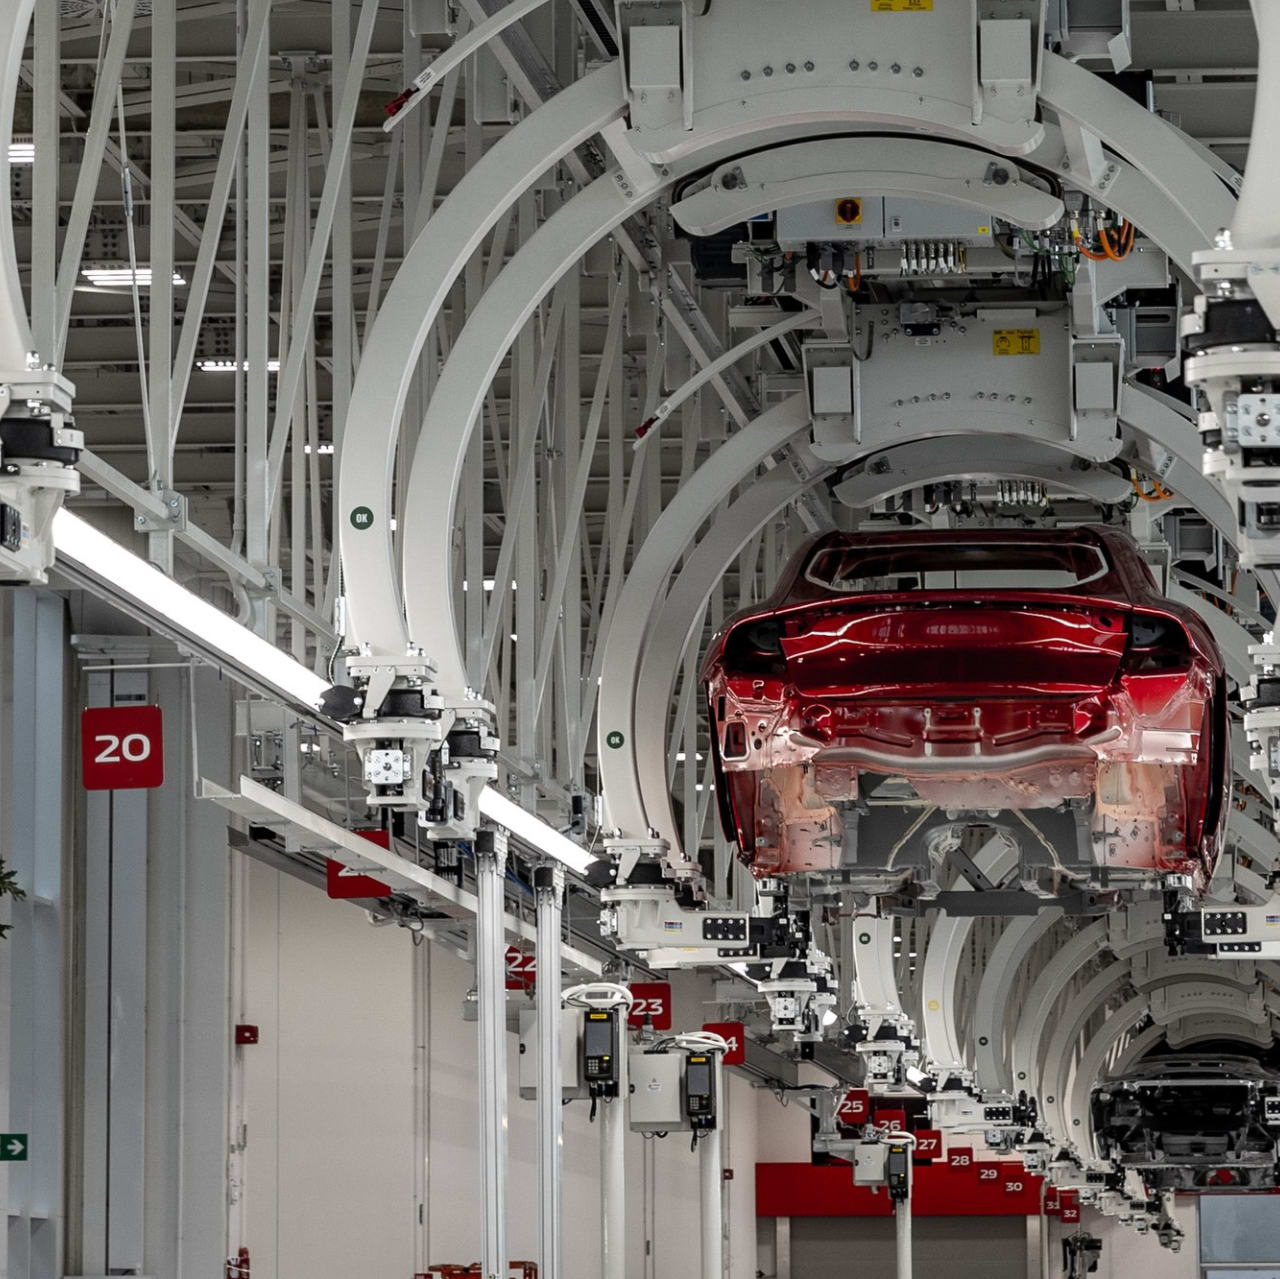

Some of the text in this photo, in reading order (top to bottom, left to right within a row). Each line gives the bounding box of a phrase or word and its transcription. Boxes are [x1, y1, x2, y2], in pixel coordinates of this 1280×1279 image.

[356, 513, 368, 523] OK
[95, 733, 151, 763] 20
[632, 999, 664, 1016] 23
[840, 1100, 864, 1113] 25
[879, 1120, 901, 1132] 26
[919, 1139, 937, 1150] 27
[951, 1155, 970, 1166] 28
[980, 1169, 998, 1179] 29
[1005, 1182, 1023, 1192] 30
[1063, 1209, 1078, 1218] 32
